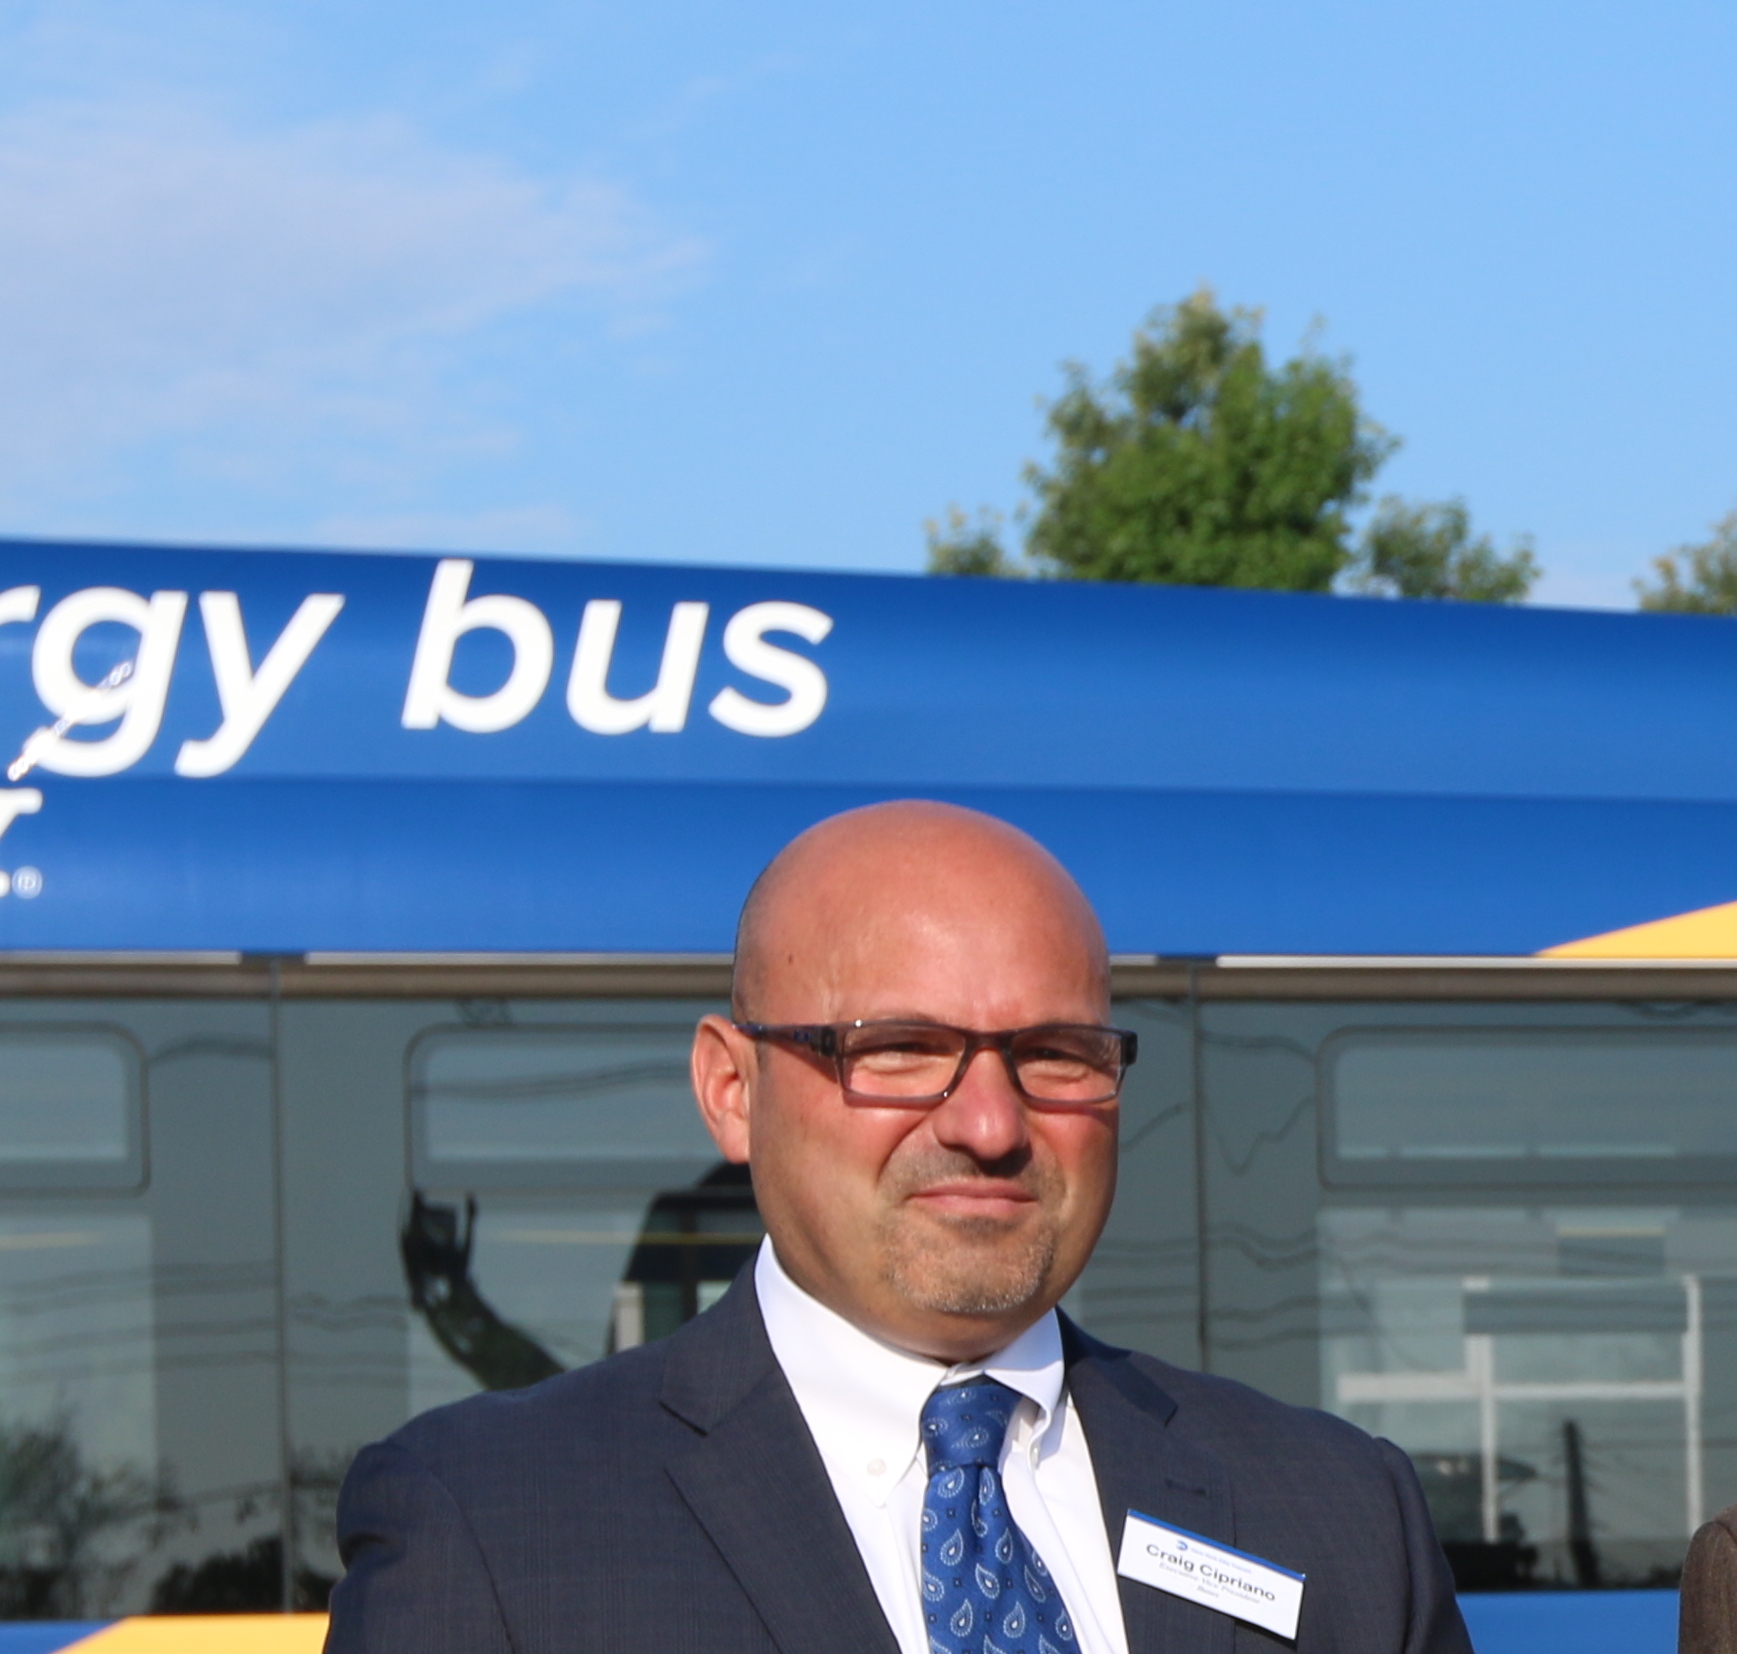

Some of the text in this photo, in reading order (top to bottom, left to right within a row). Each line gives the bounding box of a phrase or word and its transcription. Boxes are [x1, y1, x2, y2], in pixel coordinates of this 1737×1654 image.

[401, 558, 834, 738] bus
[1146, 1543, 1195, 1573] Craig
[1199, 1563, 1276, 1601] Cipriano
